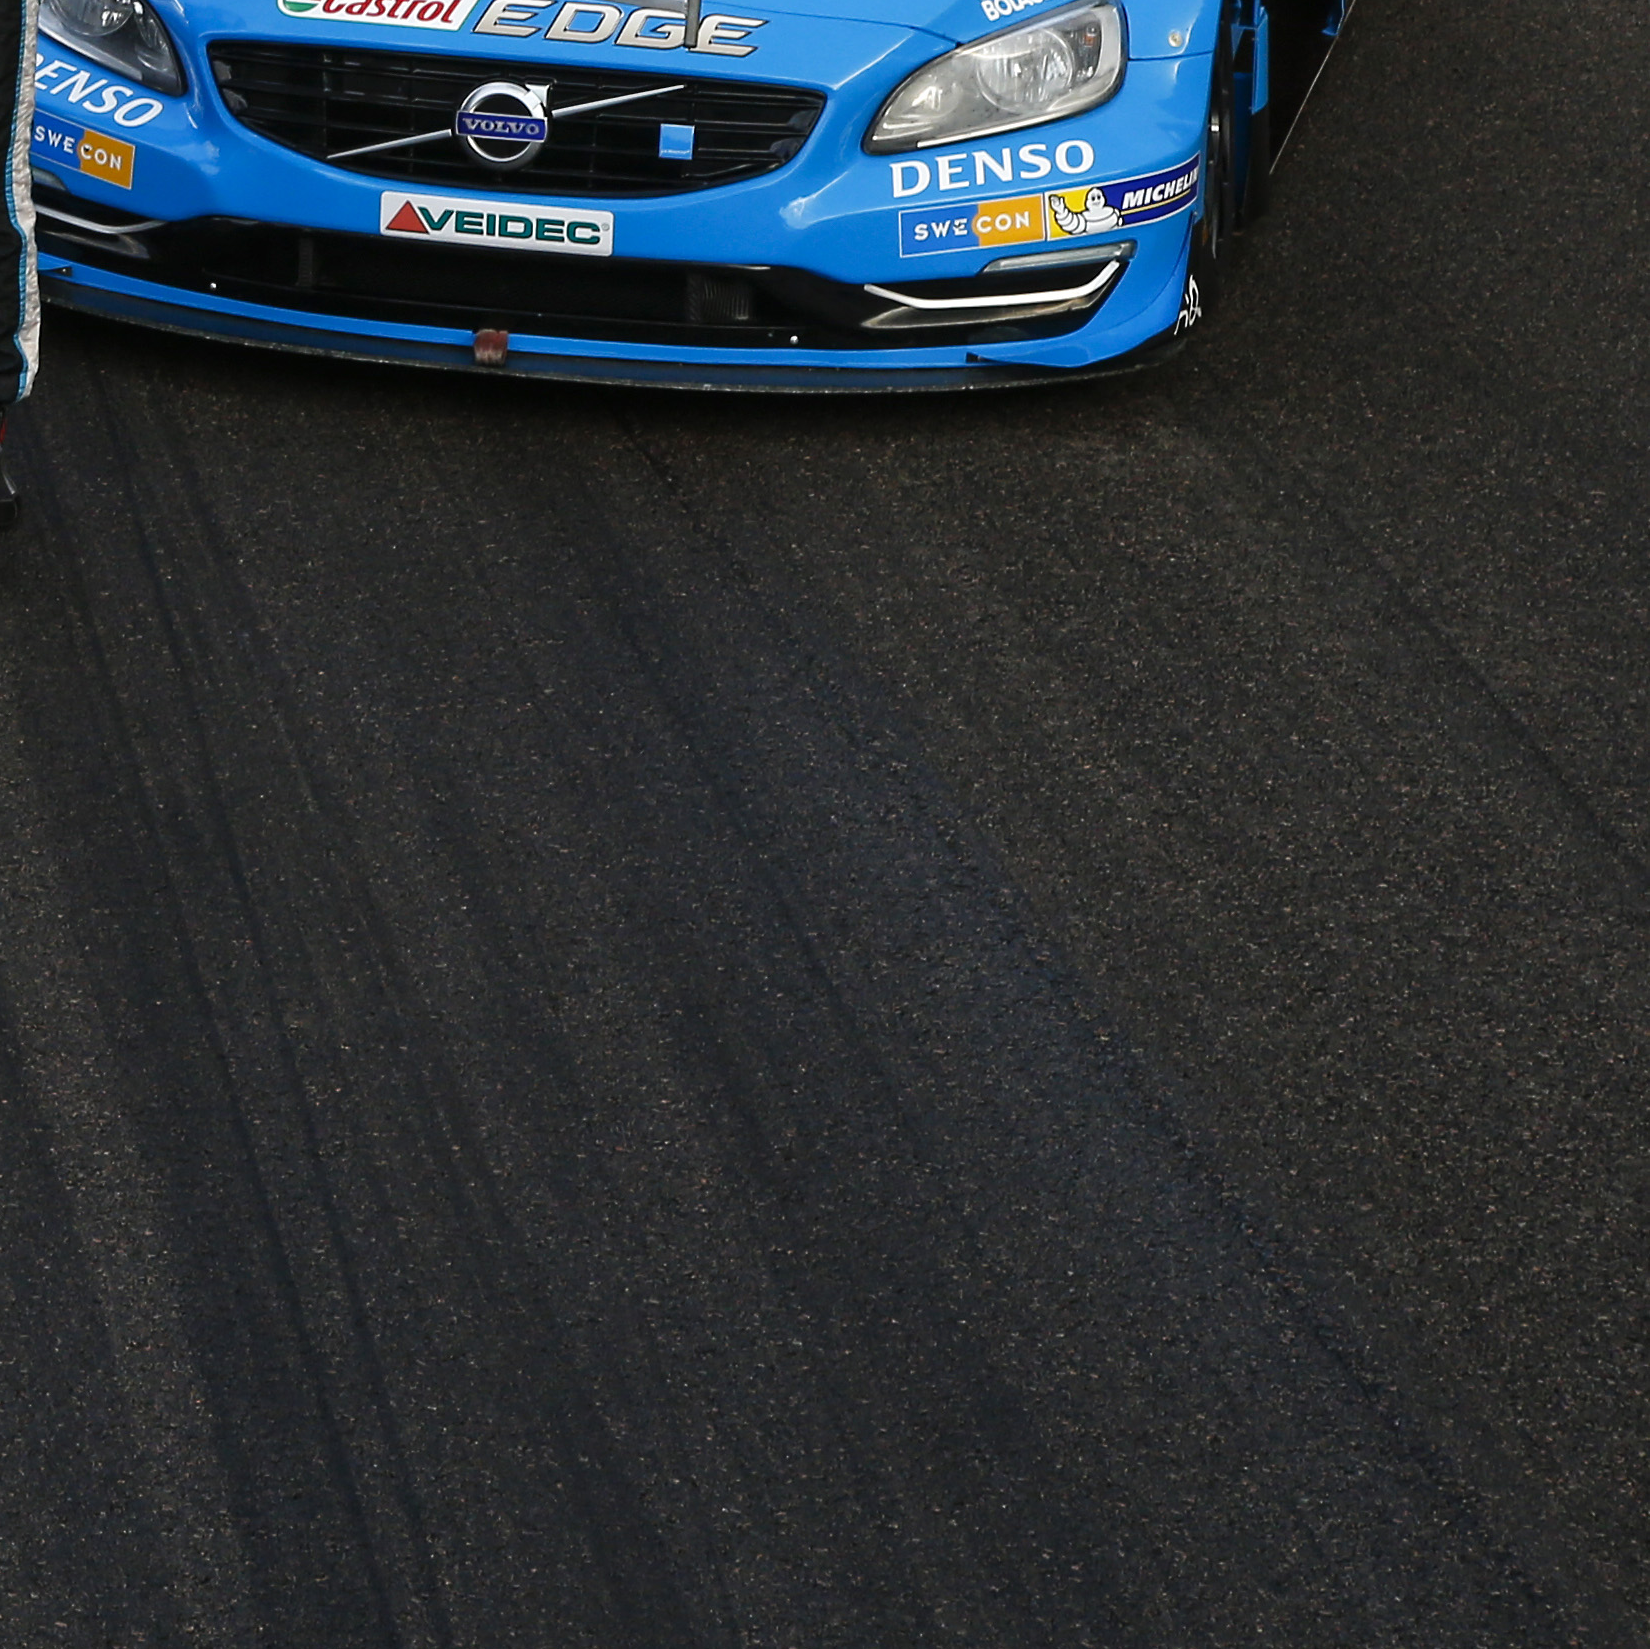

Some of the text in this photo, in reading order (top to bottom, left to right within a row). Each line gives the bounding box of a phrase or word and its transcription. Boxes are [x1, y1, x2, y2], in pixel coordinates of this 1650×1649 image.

[35, 55, 164, 128] ENSO
[461, 116, 542, 137] VOLVO
[890, 139, 1095, 199] DENSO
[416, 206, 600, 246] VEIDEC
